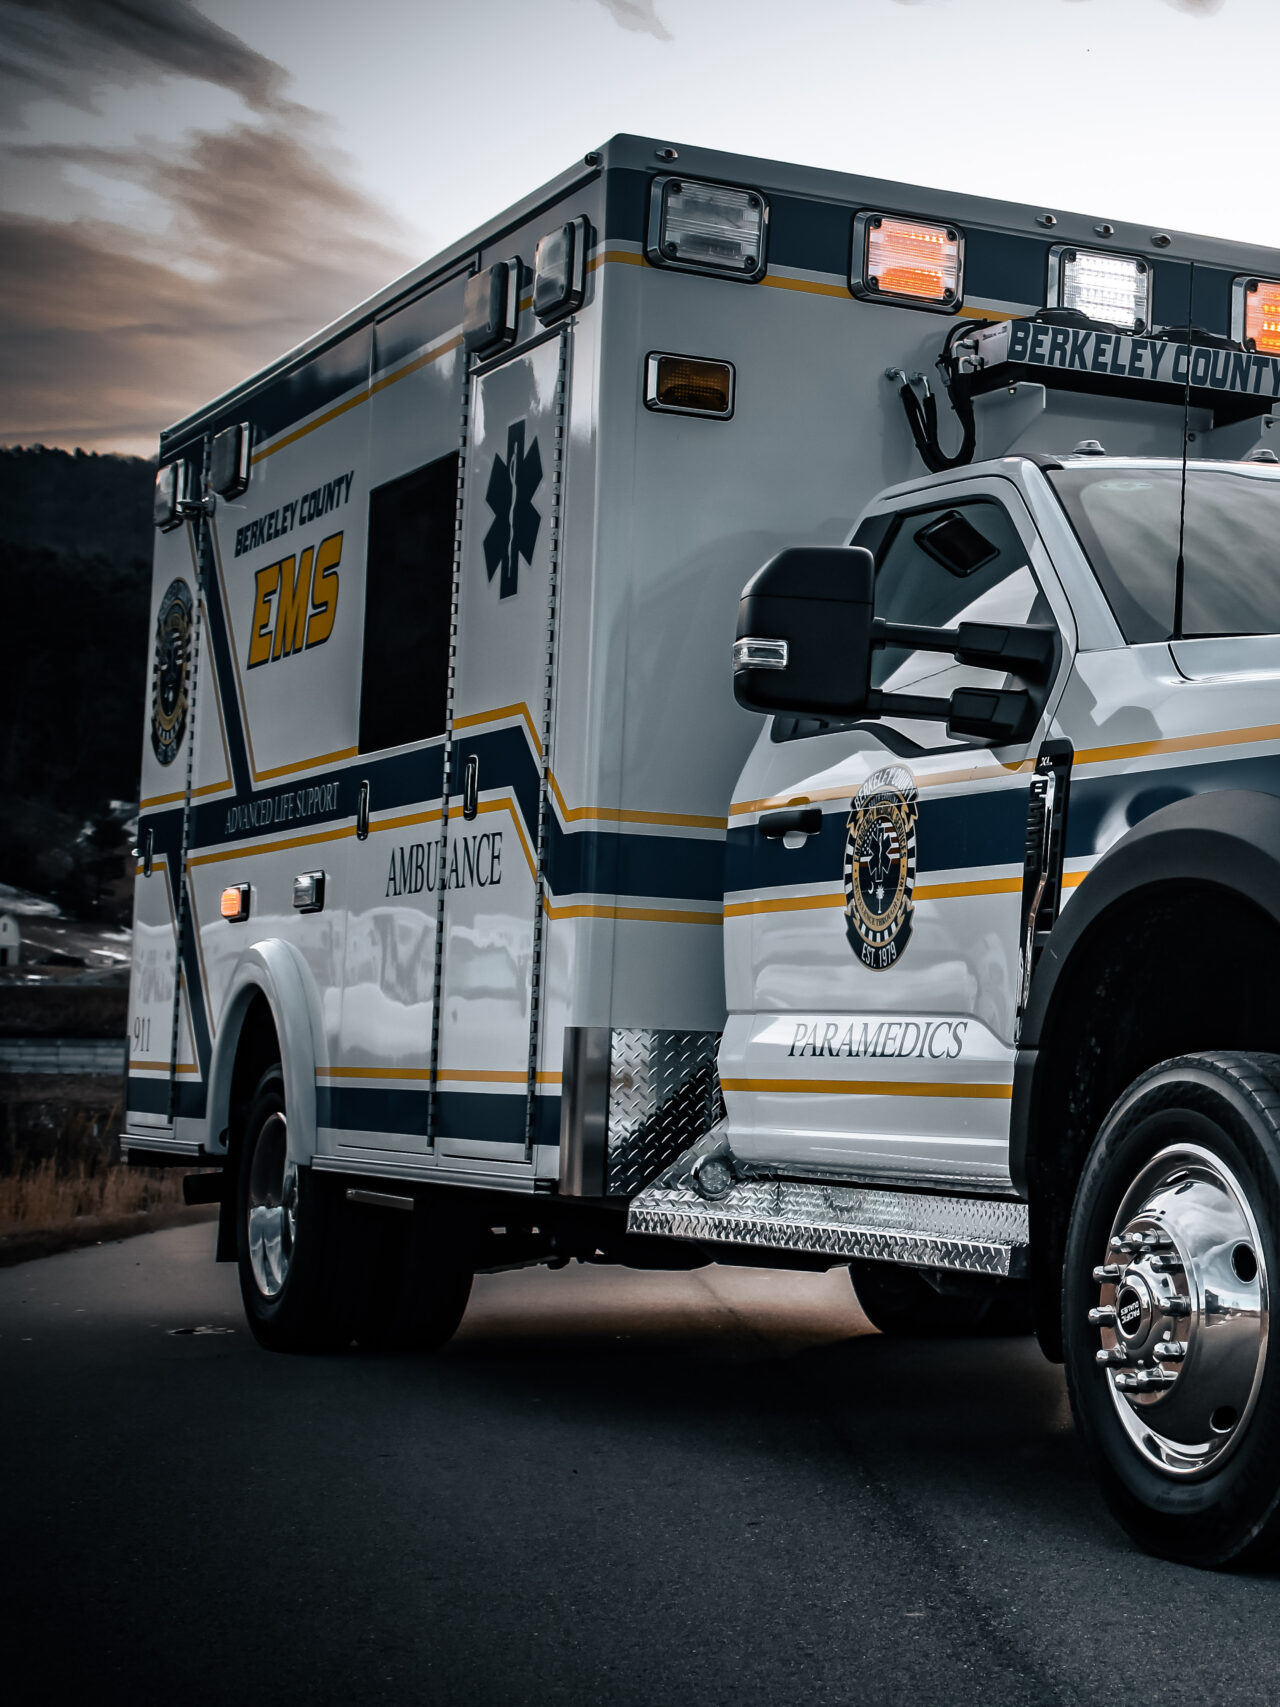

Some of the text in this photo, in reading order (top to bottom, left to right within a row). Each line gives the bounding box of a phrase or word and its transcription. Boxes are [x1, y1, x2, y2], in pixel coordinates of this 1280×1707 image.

[1008, 321, 1167, 379] BERKELEY
[234, 470, 354, 558] BERKELEY COUNTY
[247, 530, 344, 670] EMS
[1040, 756, 1053, 767] XL
[224, 781, 340, 835] ADVANCED LIFE SUPPORT
[854, 767, 896, 810] BERKELEY
[861, 941, 897, 968] EST. 1979
[133, 1016, 151, 1052] 911
[787, 1021, 968, 1059] PARAMEDICS
